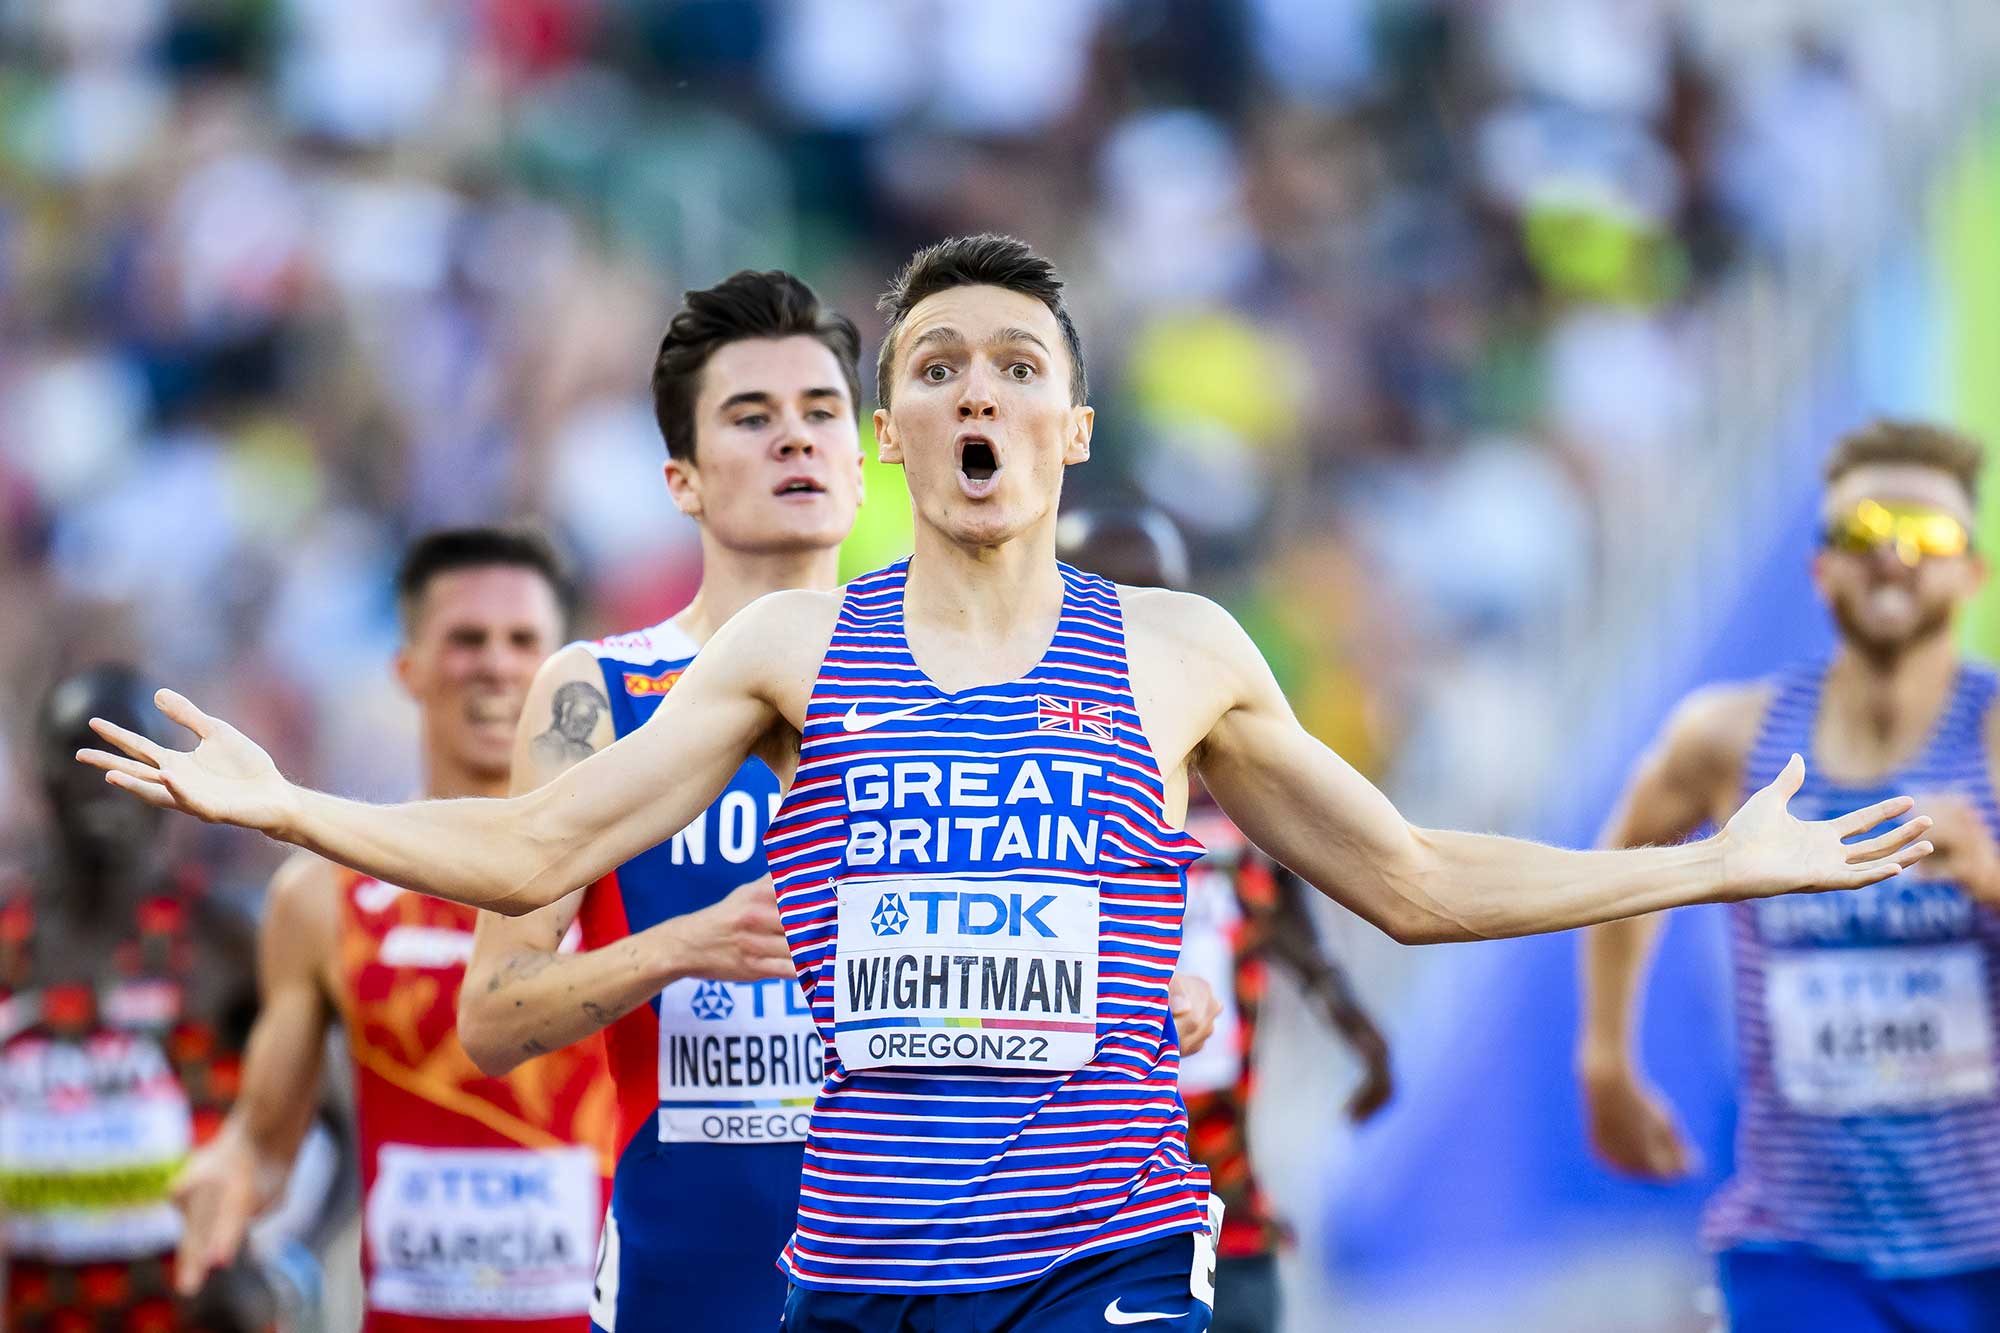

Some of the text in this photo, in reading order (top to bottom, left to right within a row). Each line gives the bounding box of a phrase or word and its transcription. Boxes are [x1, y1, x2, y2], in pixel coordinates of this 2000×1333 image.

[844, 759, 1103, 812] GREAT
[845, 813, 1100, 867] BRITAIN
[909, 890, 1059, 939] TDK
[846, 953, 1084, 1015] WIGHTMAN
[669, 1032, 825, 1088] INGEBRIG
[868, 1033, 1049, 1063] OREGON22
[702, 1114, 811, 1140] OREGO
